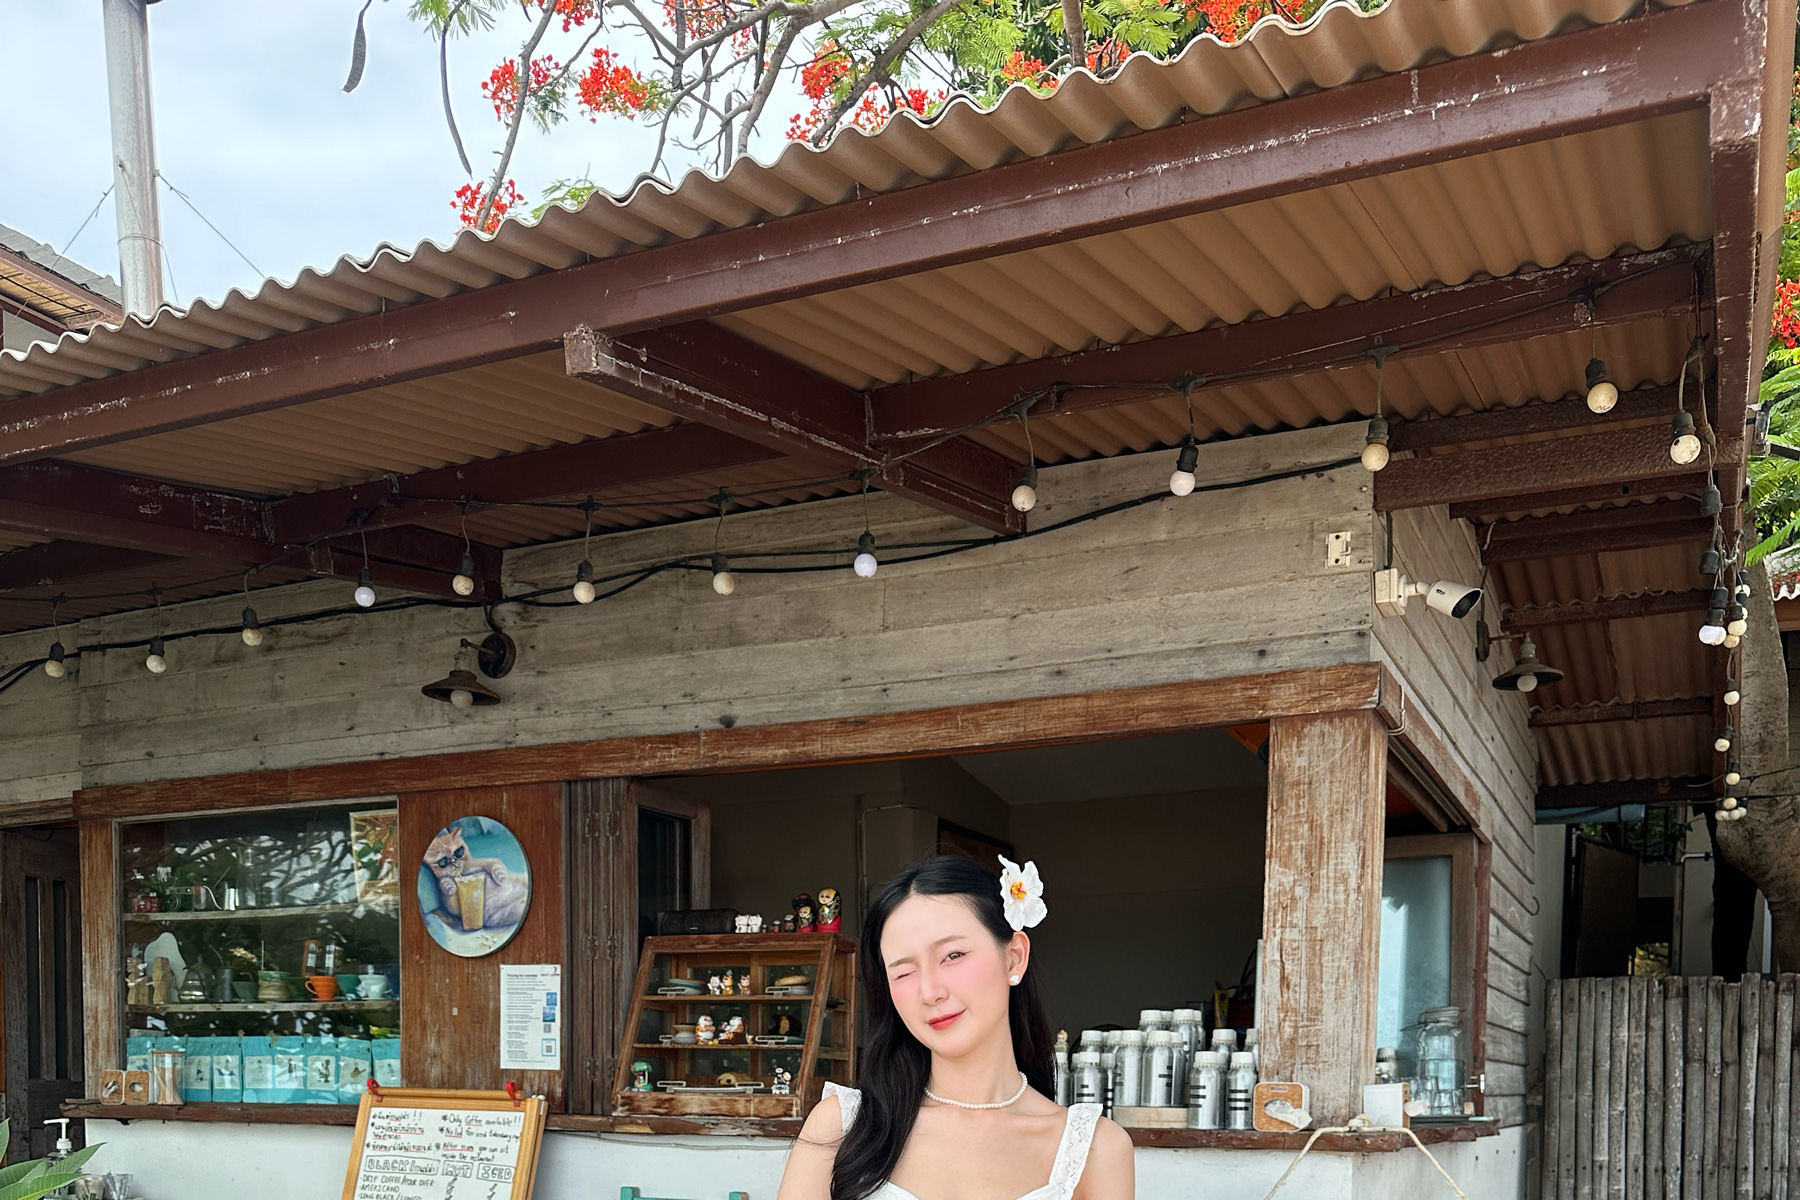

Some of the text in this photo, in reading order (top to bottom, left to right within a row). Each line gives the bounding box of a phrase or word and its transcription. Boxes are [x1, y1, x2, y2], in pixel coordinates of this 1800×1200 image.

[481, 1165, 512, 1180] ICED
[362, 1174, 378, 1182] DRIP
[418, 1179, 434, 1187] OVER
[360, 1183, 400, 1193] AMERICANO
